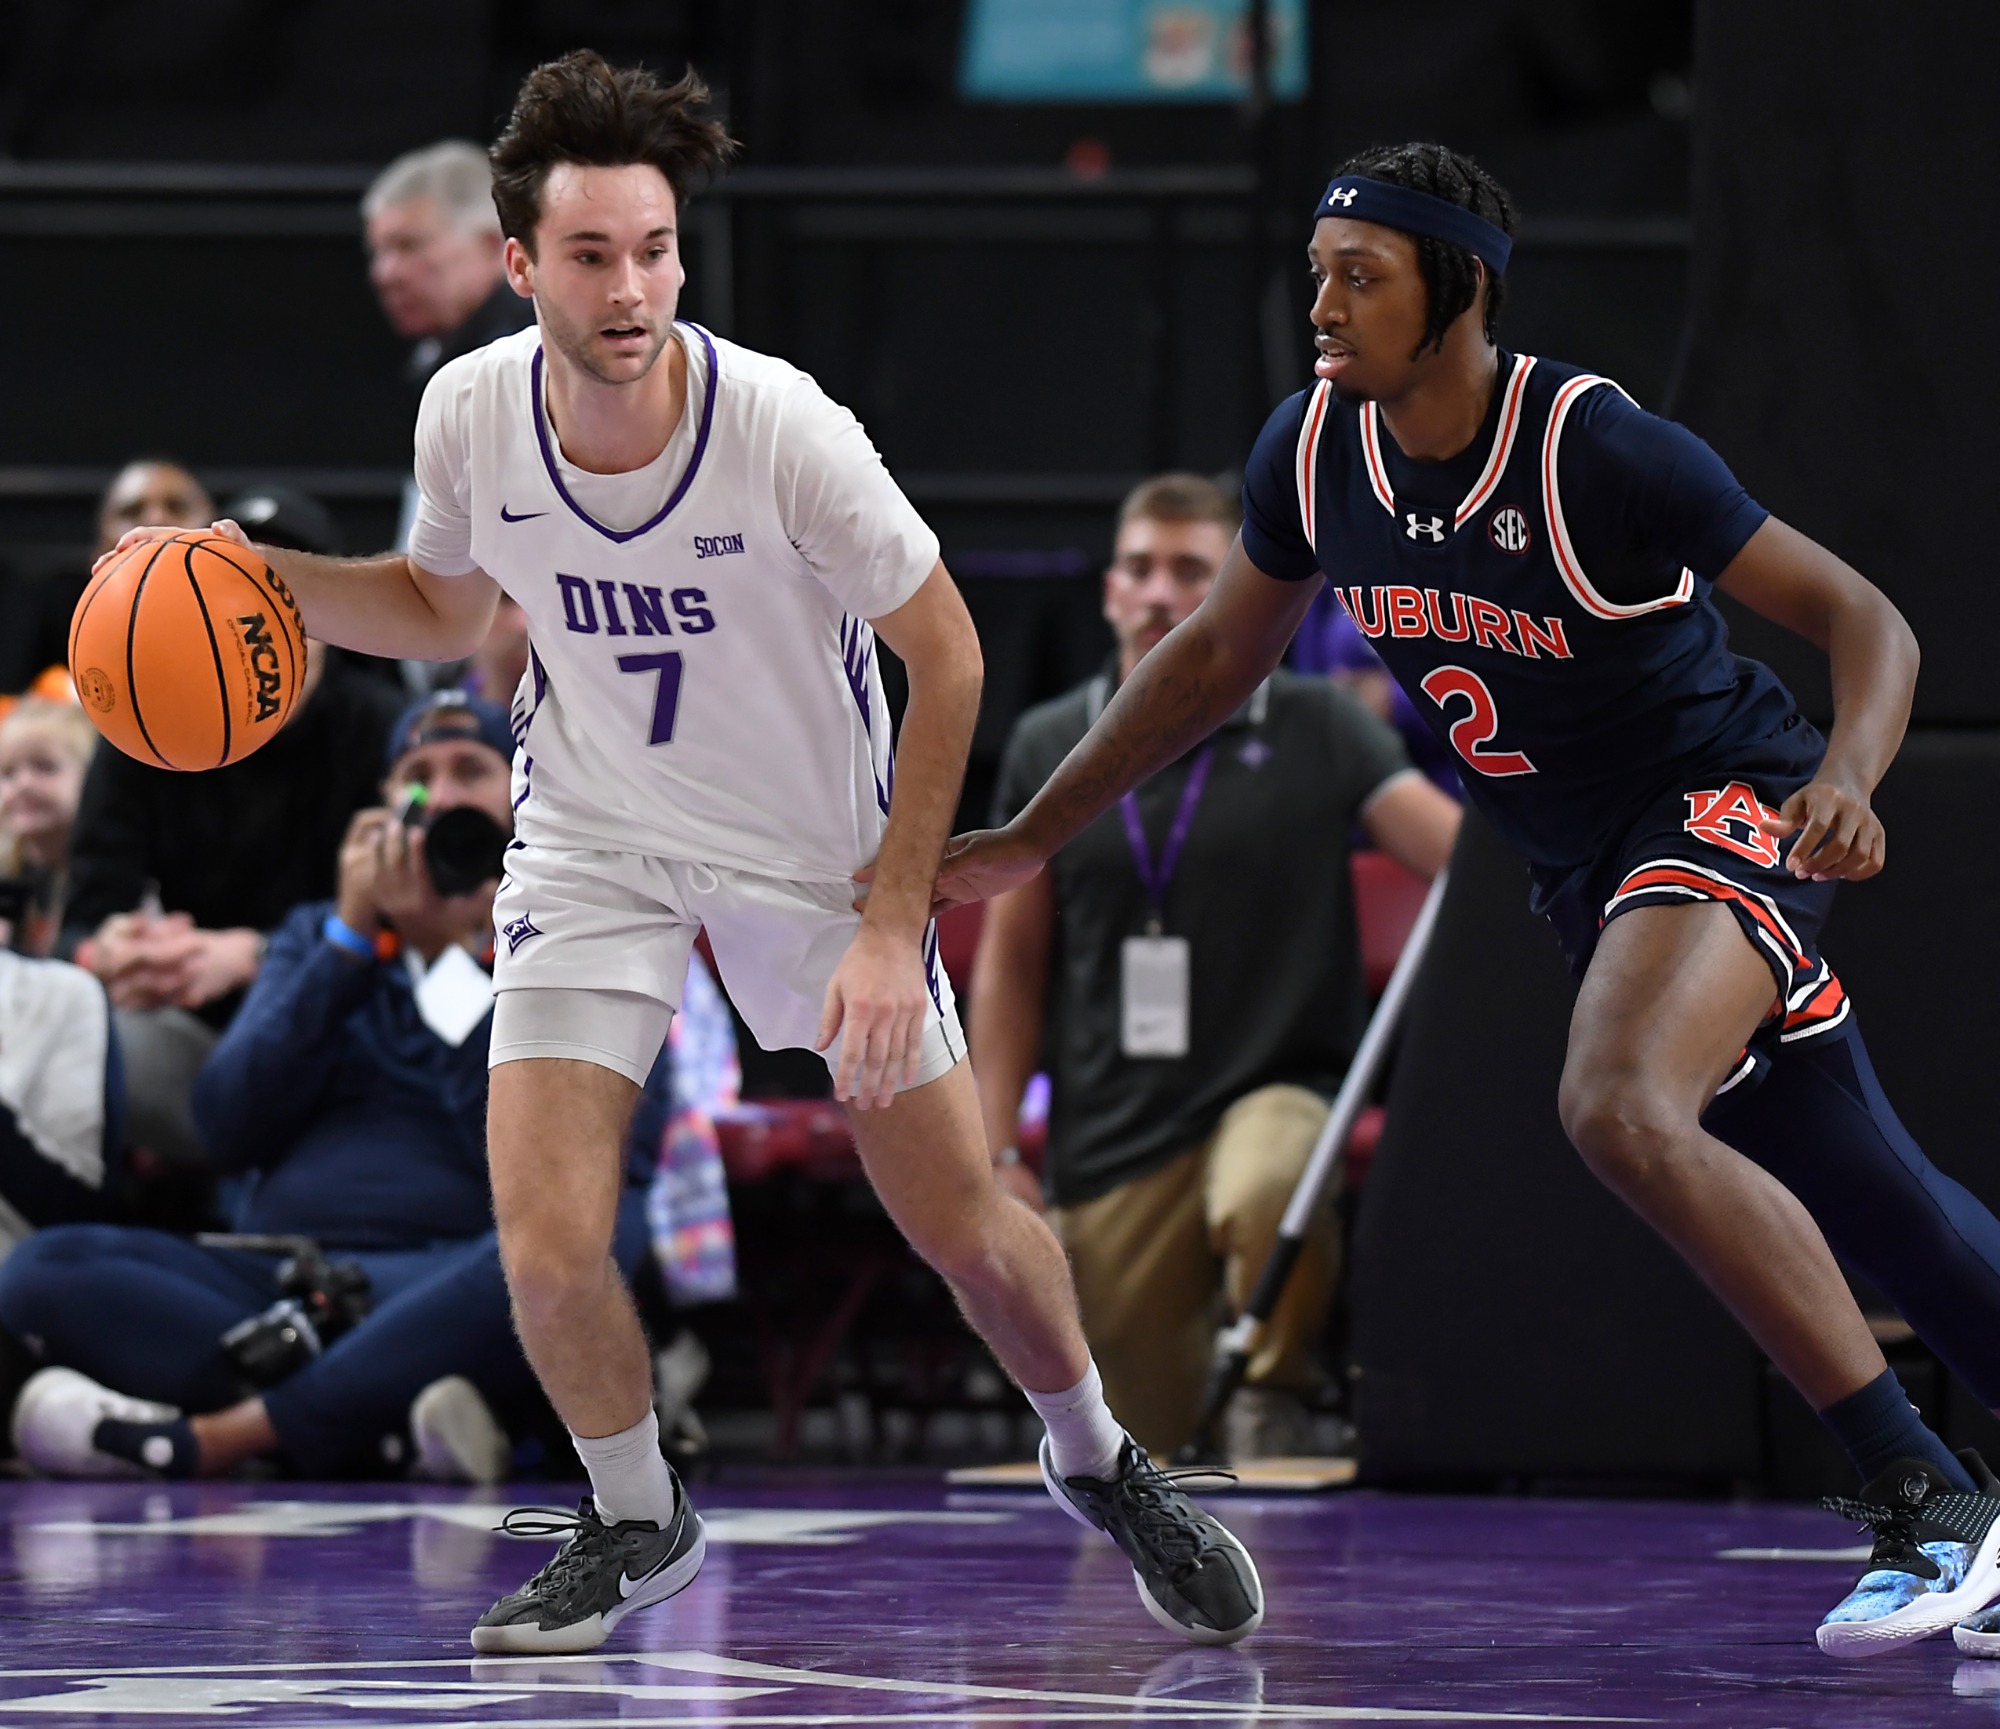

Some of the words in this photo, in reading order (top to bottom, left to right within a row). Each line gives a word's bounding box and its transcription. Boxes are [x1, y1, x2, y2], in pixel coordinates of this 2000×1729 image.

[1492, 508, 1527, 551] SEC
[555, 572, 717, 637] DINS
[236, 611, 282, 724] NCAA
[614, 650, 685, 747] 7
[1420, 664, 1539, 777] 2
